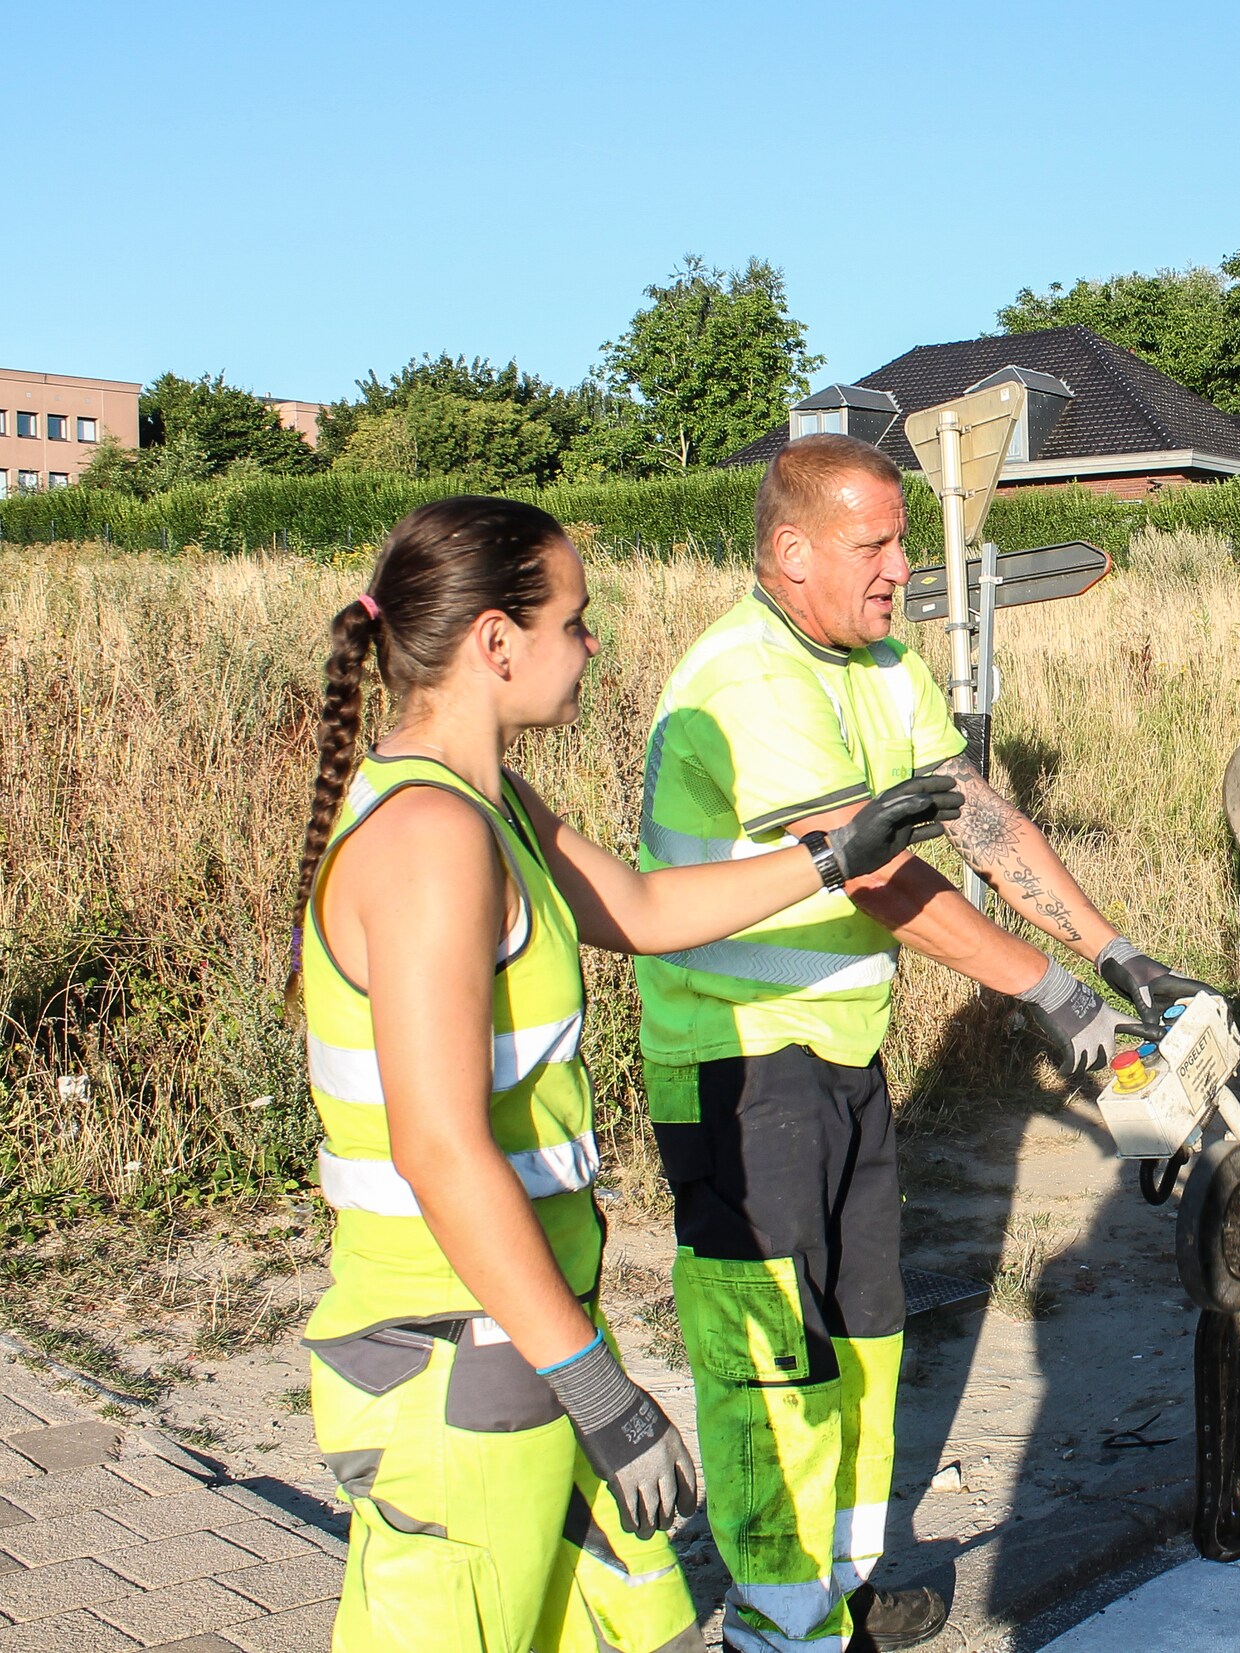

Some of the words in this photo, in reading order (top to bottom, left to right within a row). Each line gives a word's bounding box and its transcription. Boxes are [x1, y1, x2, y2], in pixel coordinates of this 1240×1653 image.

[1010, 860, 1045, 900] Stay
[1044, 892, 1082, 942] Strong
[1179, 1035, 1208, 1077] OPGELET
